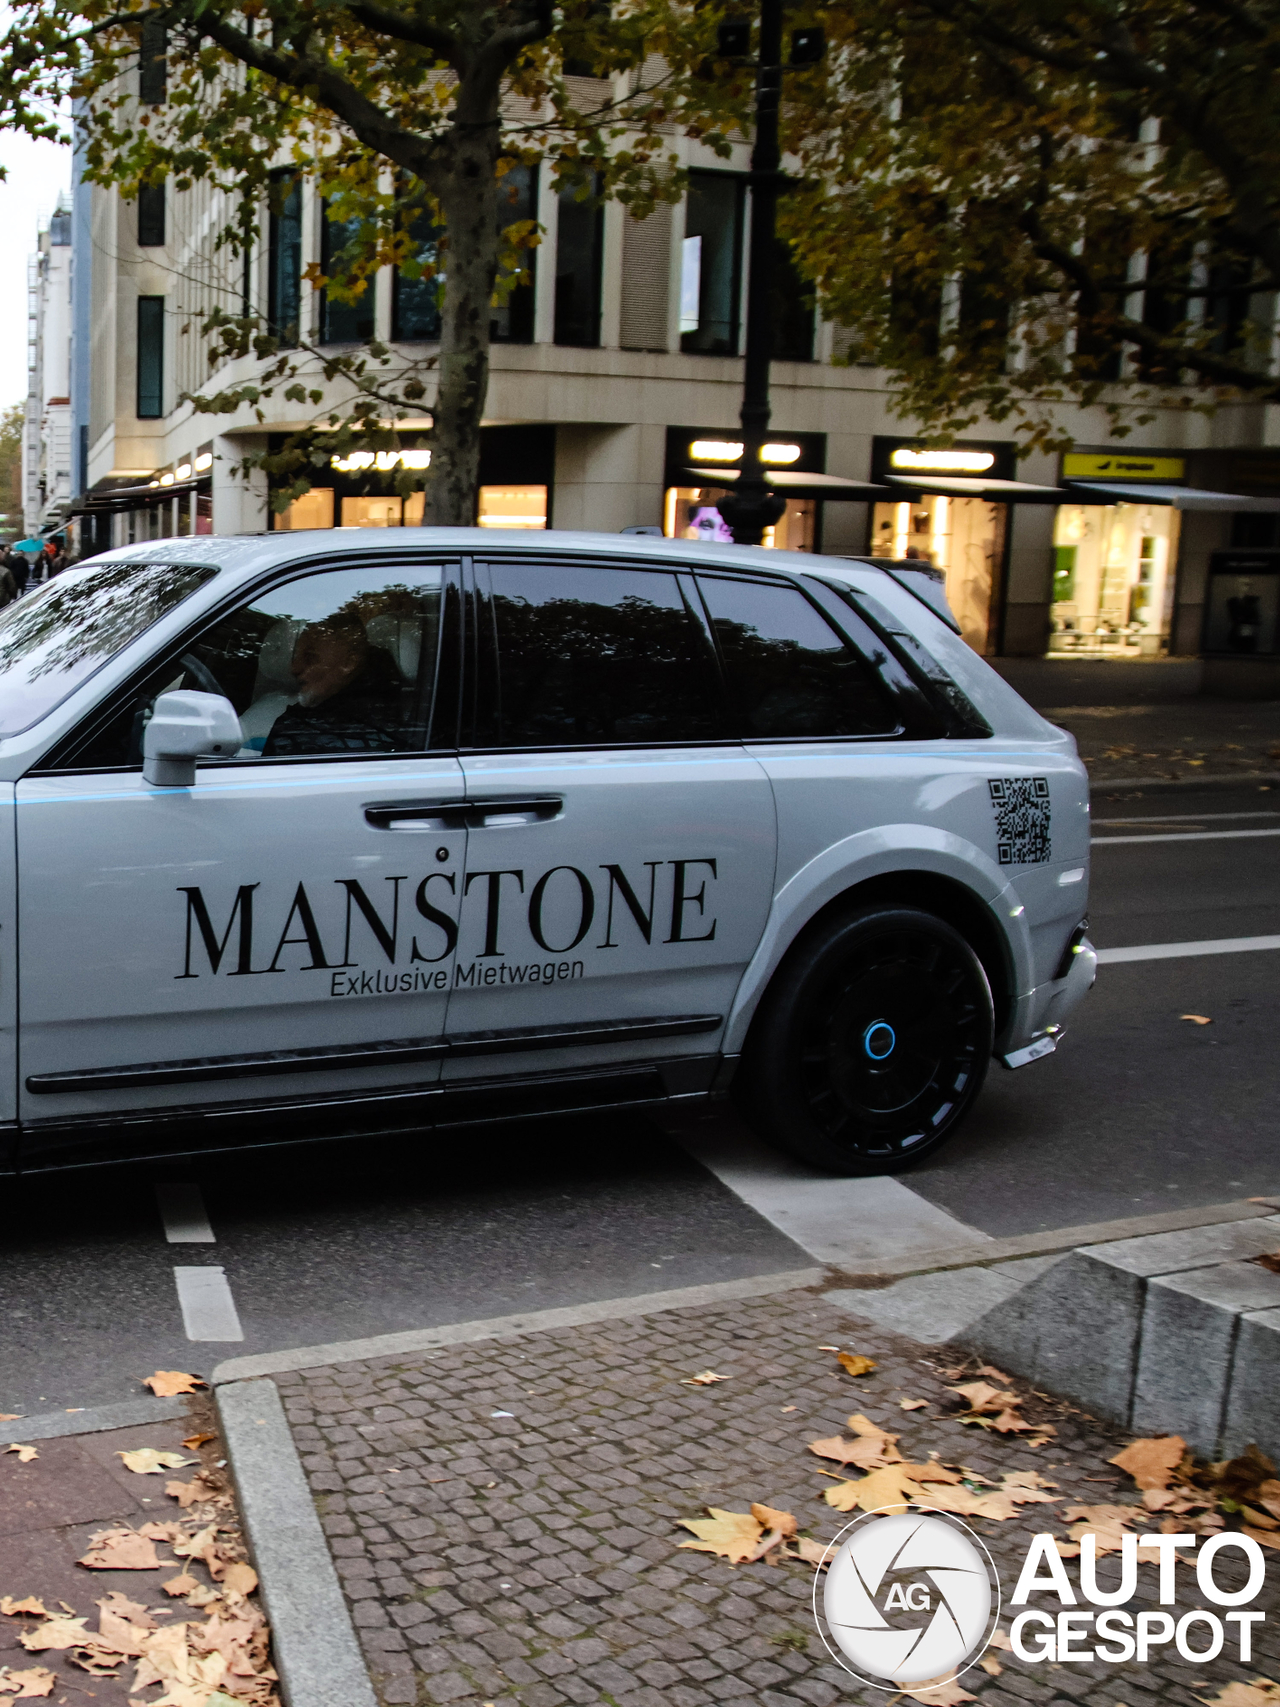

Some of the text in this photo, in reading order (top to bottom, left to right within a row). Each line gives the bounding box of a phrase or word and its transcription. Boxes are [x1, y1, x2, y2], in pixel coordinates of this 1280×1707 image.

[173, 857, 718, 980] MANSTONE
[330, 960, 584, 997] Exklusive Mietwagen
